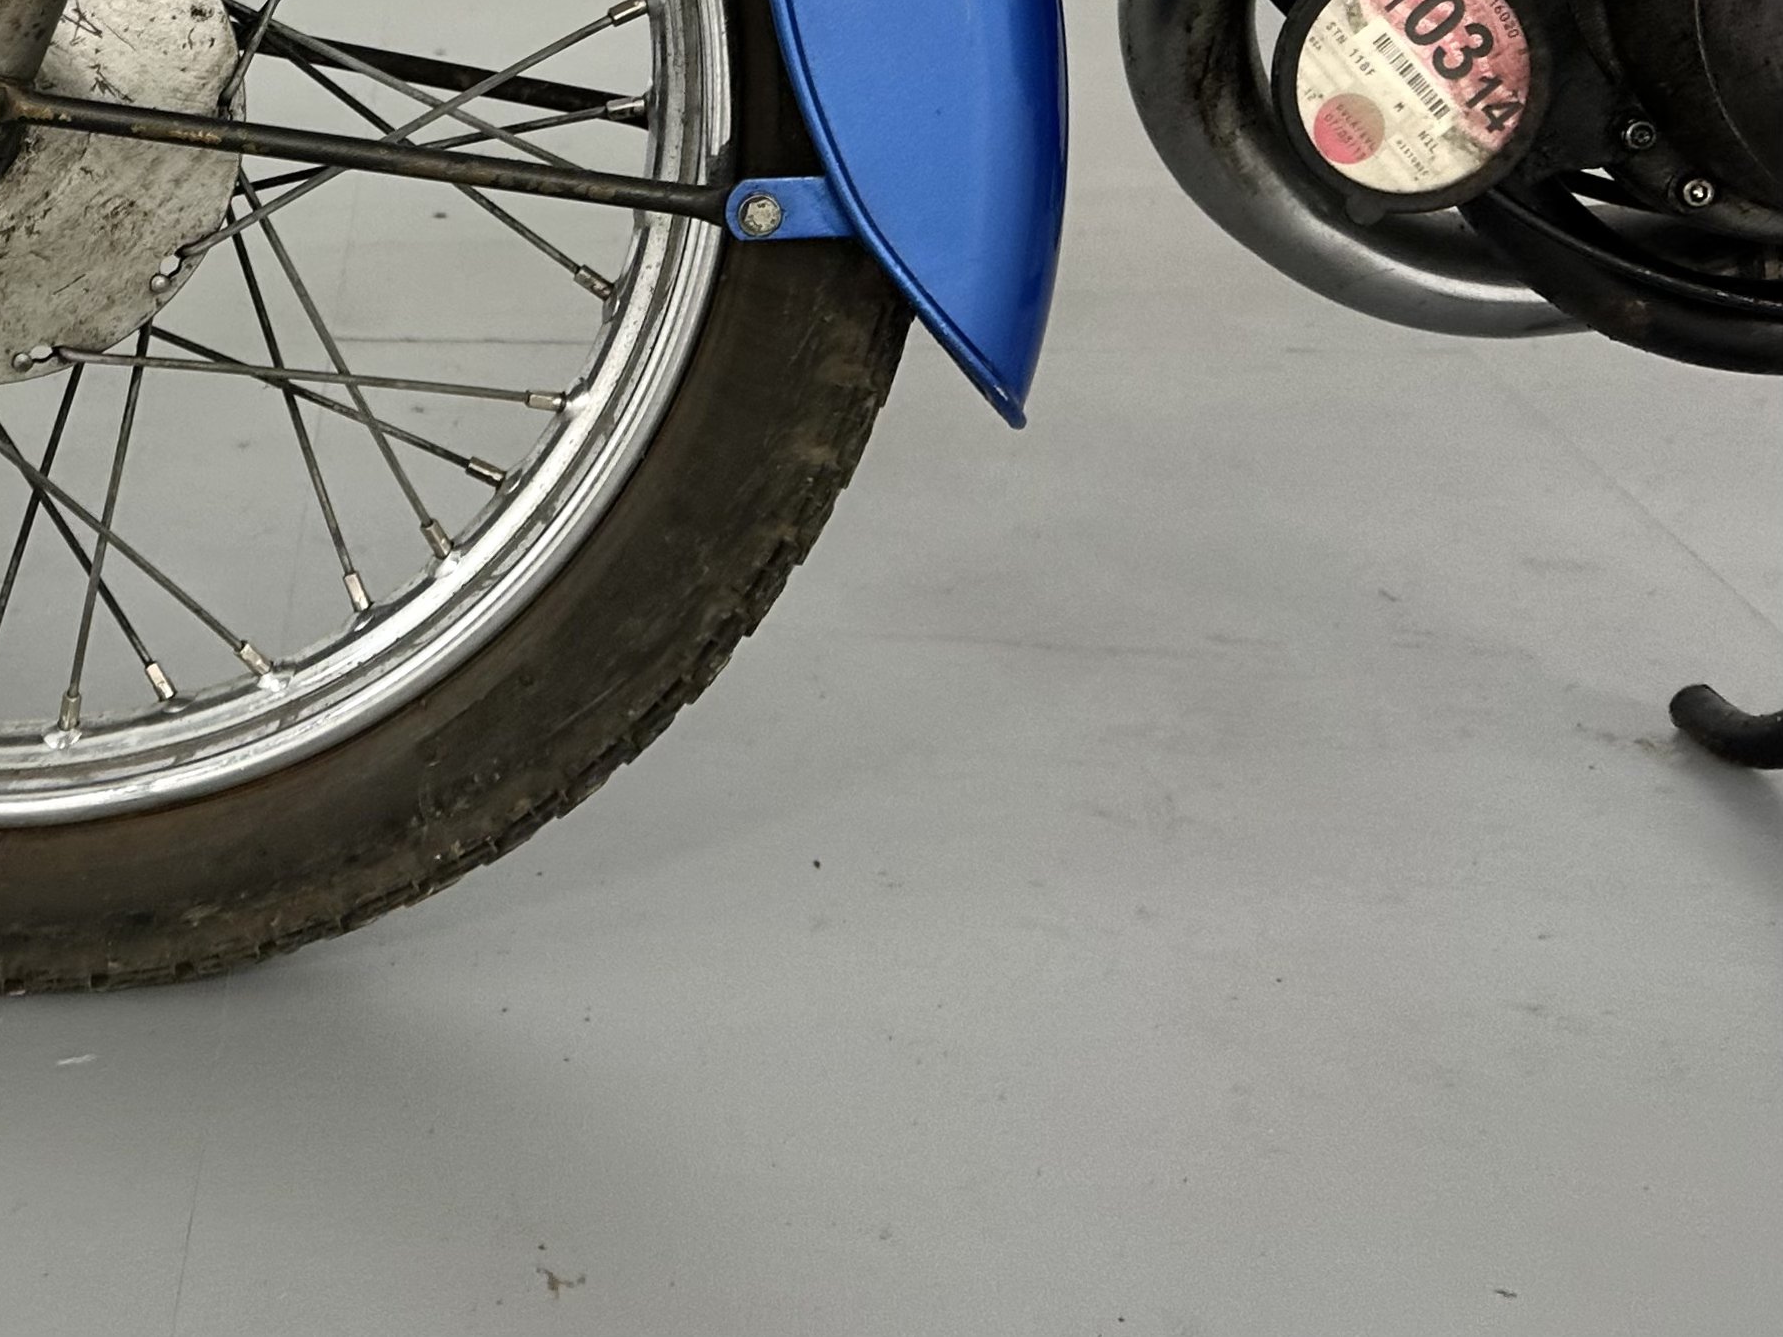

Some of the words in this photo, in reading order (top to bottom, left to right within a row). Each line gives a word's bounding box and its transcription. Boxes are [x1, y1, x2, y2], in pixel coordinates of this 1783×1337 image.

[1324, 19, 1349, 45] STN
[1347, 46, 1377, 78] 118F
[1465, 74, 1523, 133] 14
